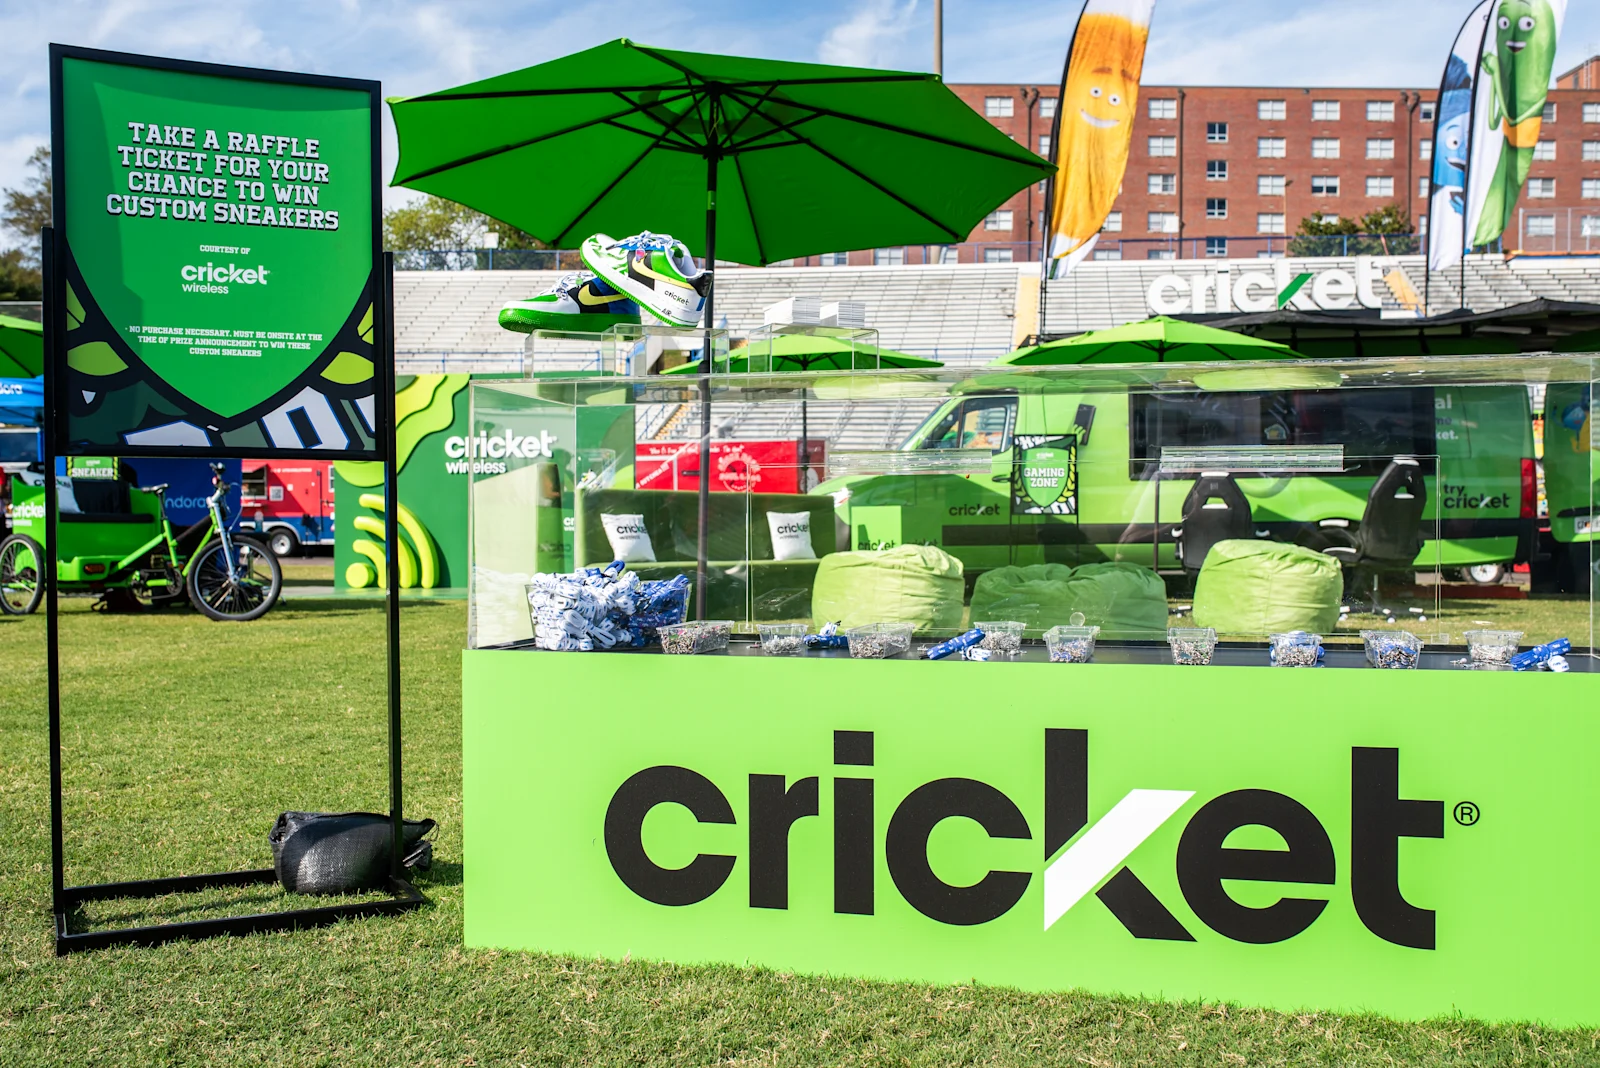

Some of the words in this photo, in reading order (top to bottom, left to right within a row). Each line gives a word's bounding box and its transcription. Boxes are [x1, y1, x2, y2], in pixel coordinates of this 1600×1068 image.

[128, 121, 196, 148] TAKE
[203, 129, 220, 150] A
[227, 131, 319, 159] RAFFLE
[117, 145, 207, 173] TICKET
[214, 154, 260, 178] FOR
[268, 158, 329, 183] YOUR
[128, 170, 227, 200] CHANCE
[234, 179, 265, 202] TO
[272, 182, 319, 207] WIN
[106, 193, 207, 222] CUSTOM
[213, 201, 339, 230] SNEAKERS
[199, 244, 239, 254] COURTESY
[240, 247, 250, 255] OF
[181, 283, 229, 294] wireless
[1147, 255, 1384, 315] cricket
[664, 290, 690, 305] cricket
[129, 325, 140, 333] NO
[142, 326, 184, 335] PURCHASE
[233, 329, 254, 338] MUST
[255, 331, 266, 339] BE
[267, 331, 294, 340] ONSITE
[307, 333, 323, 341] THE
[137, 335, 157, 343] TIME
[158, 336, 169, 344] OF
[170, 336, 193, 345] PRIZE
[194, 338, 257, 348] ANNOUNCEMENT
[258, 340, 269, 348] TO
[270, 341, 286, 349] WIN
[287, 342, 311, 350] THESE
[189, 347, 221, 356] CUSTOM
[221, 349, 262, 357] SNEAKERS
[71, 467, 114, 477] SNEAKER
[1023, 467, 1065, 477] GAMING
[1030, 478, 1059, 487] ZONE
[1443, 484, 1466, 496] try
[1443, 493, 1510, 509] cricket
[949, 503, 1001, 516] cricket
[858, 540, 896, 551] cricket
